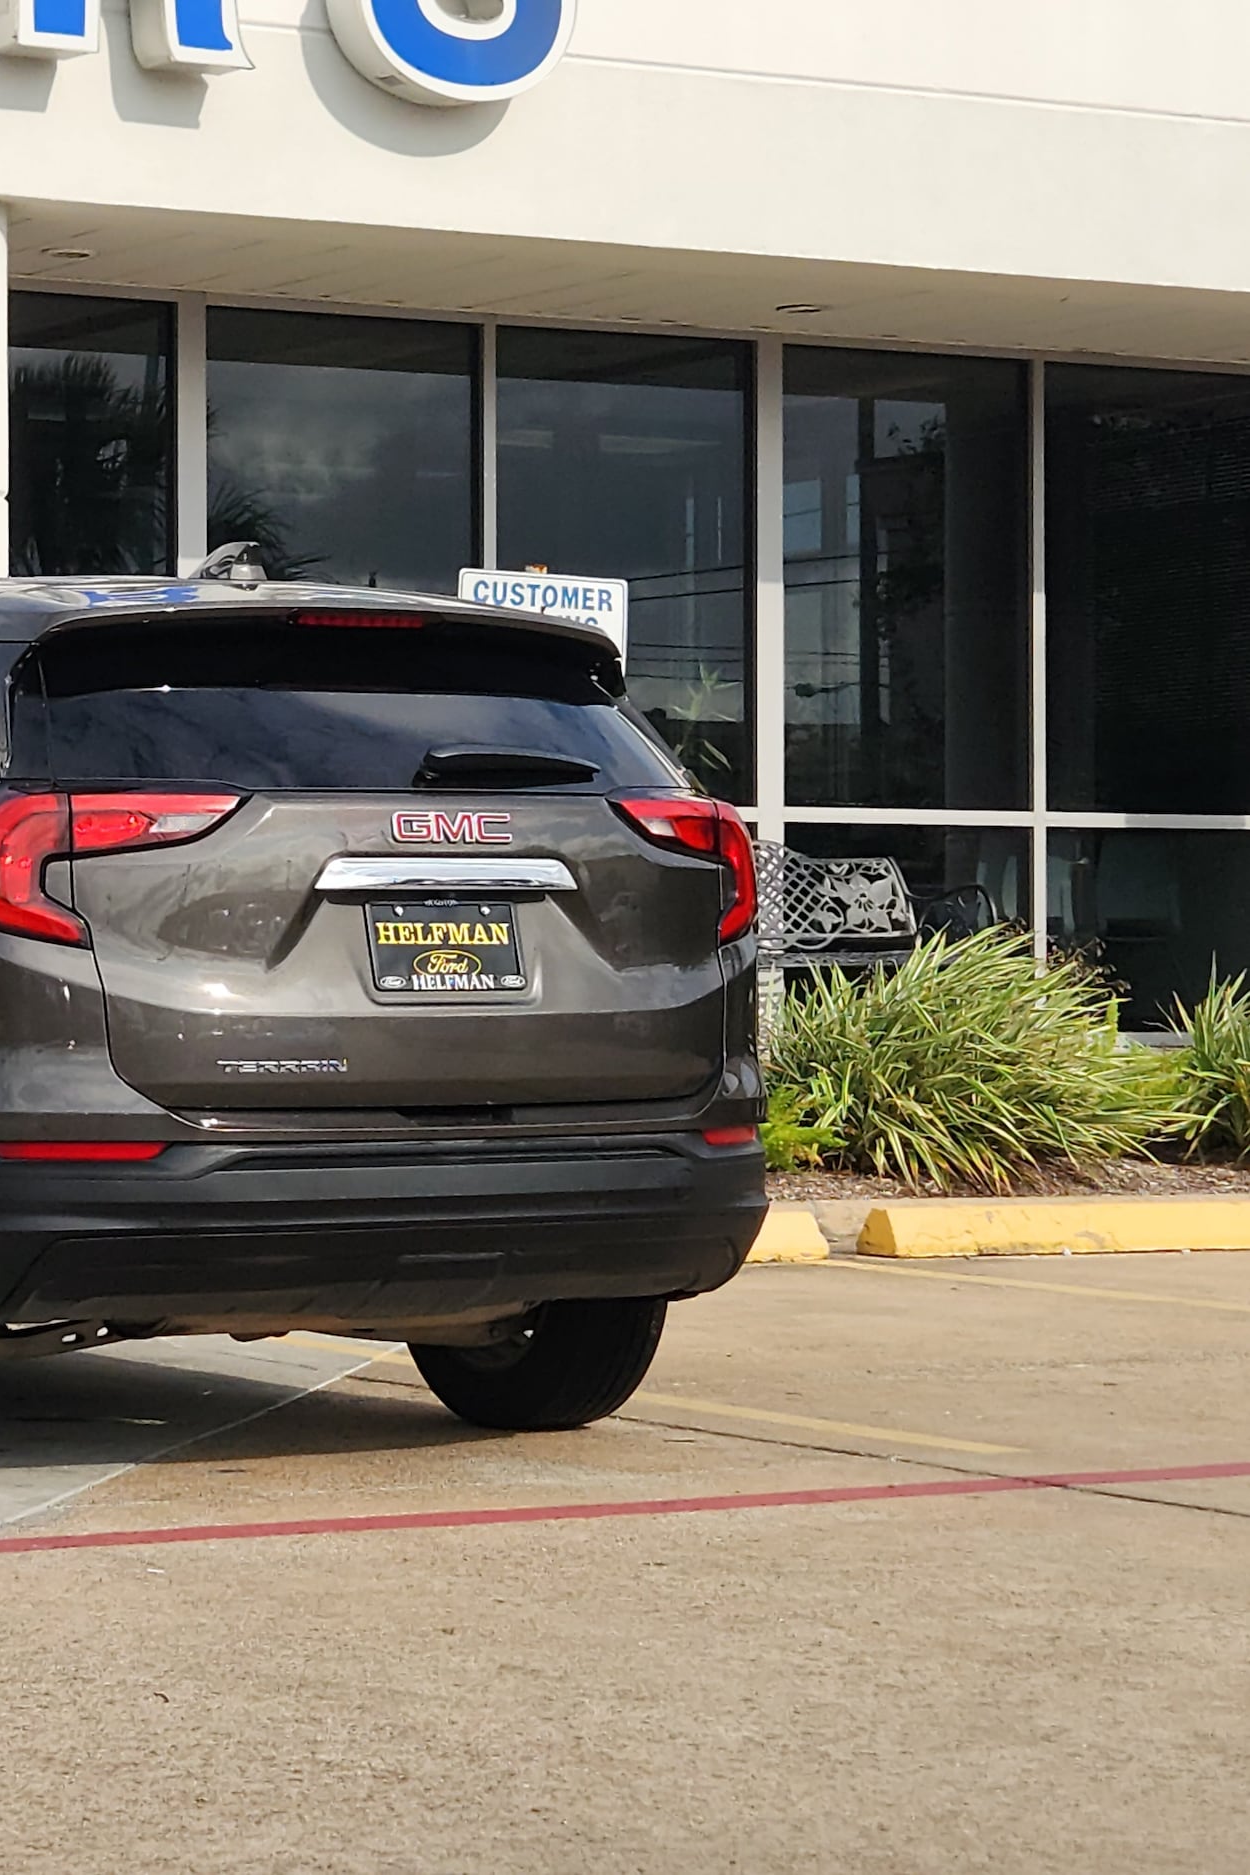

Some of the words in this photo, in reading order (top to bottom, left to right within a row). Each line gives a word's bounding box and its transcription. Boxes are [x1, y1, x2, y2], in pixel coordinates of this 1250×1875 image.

[474, 580, 613, 612] CUSTOMER
[392, 811, 512, 843] GMC
[375, 922, 510, 945] HELFMAN
[427, 953, 469, 974] Ford
[411, 974, 495, 991] HELFMAN
[216, 1058, 348, 1073] TERRAIN
